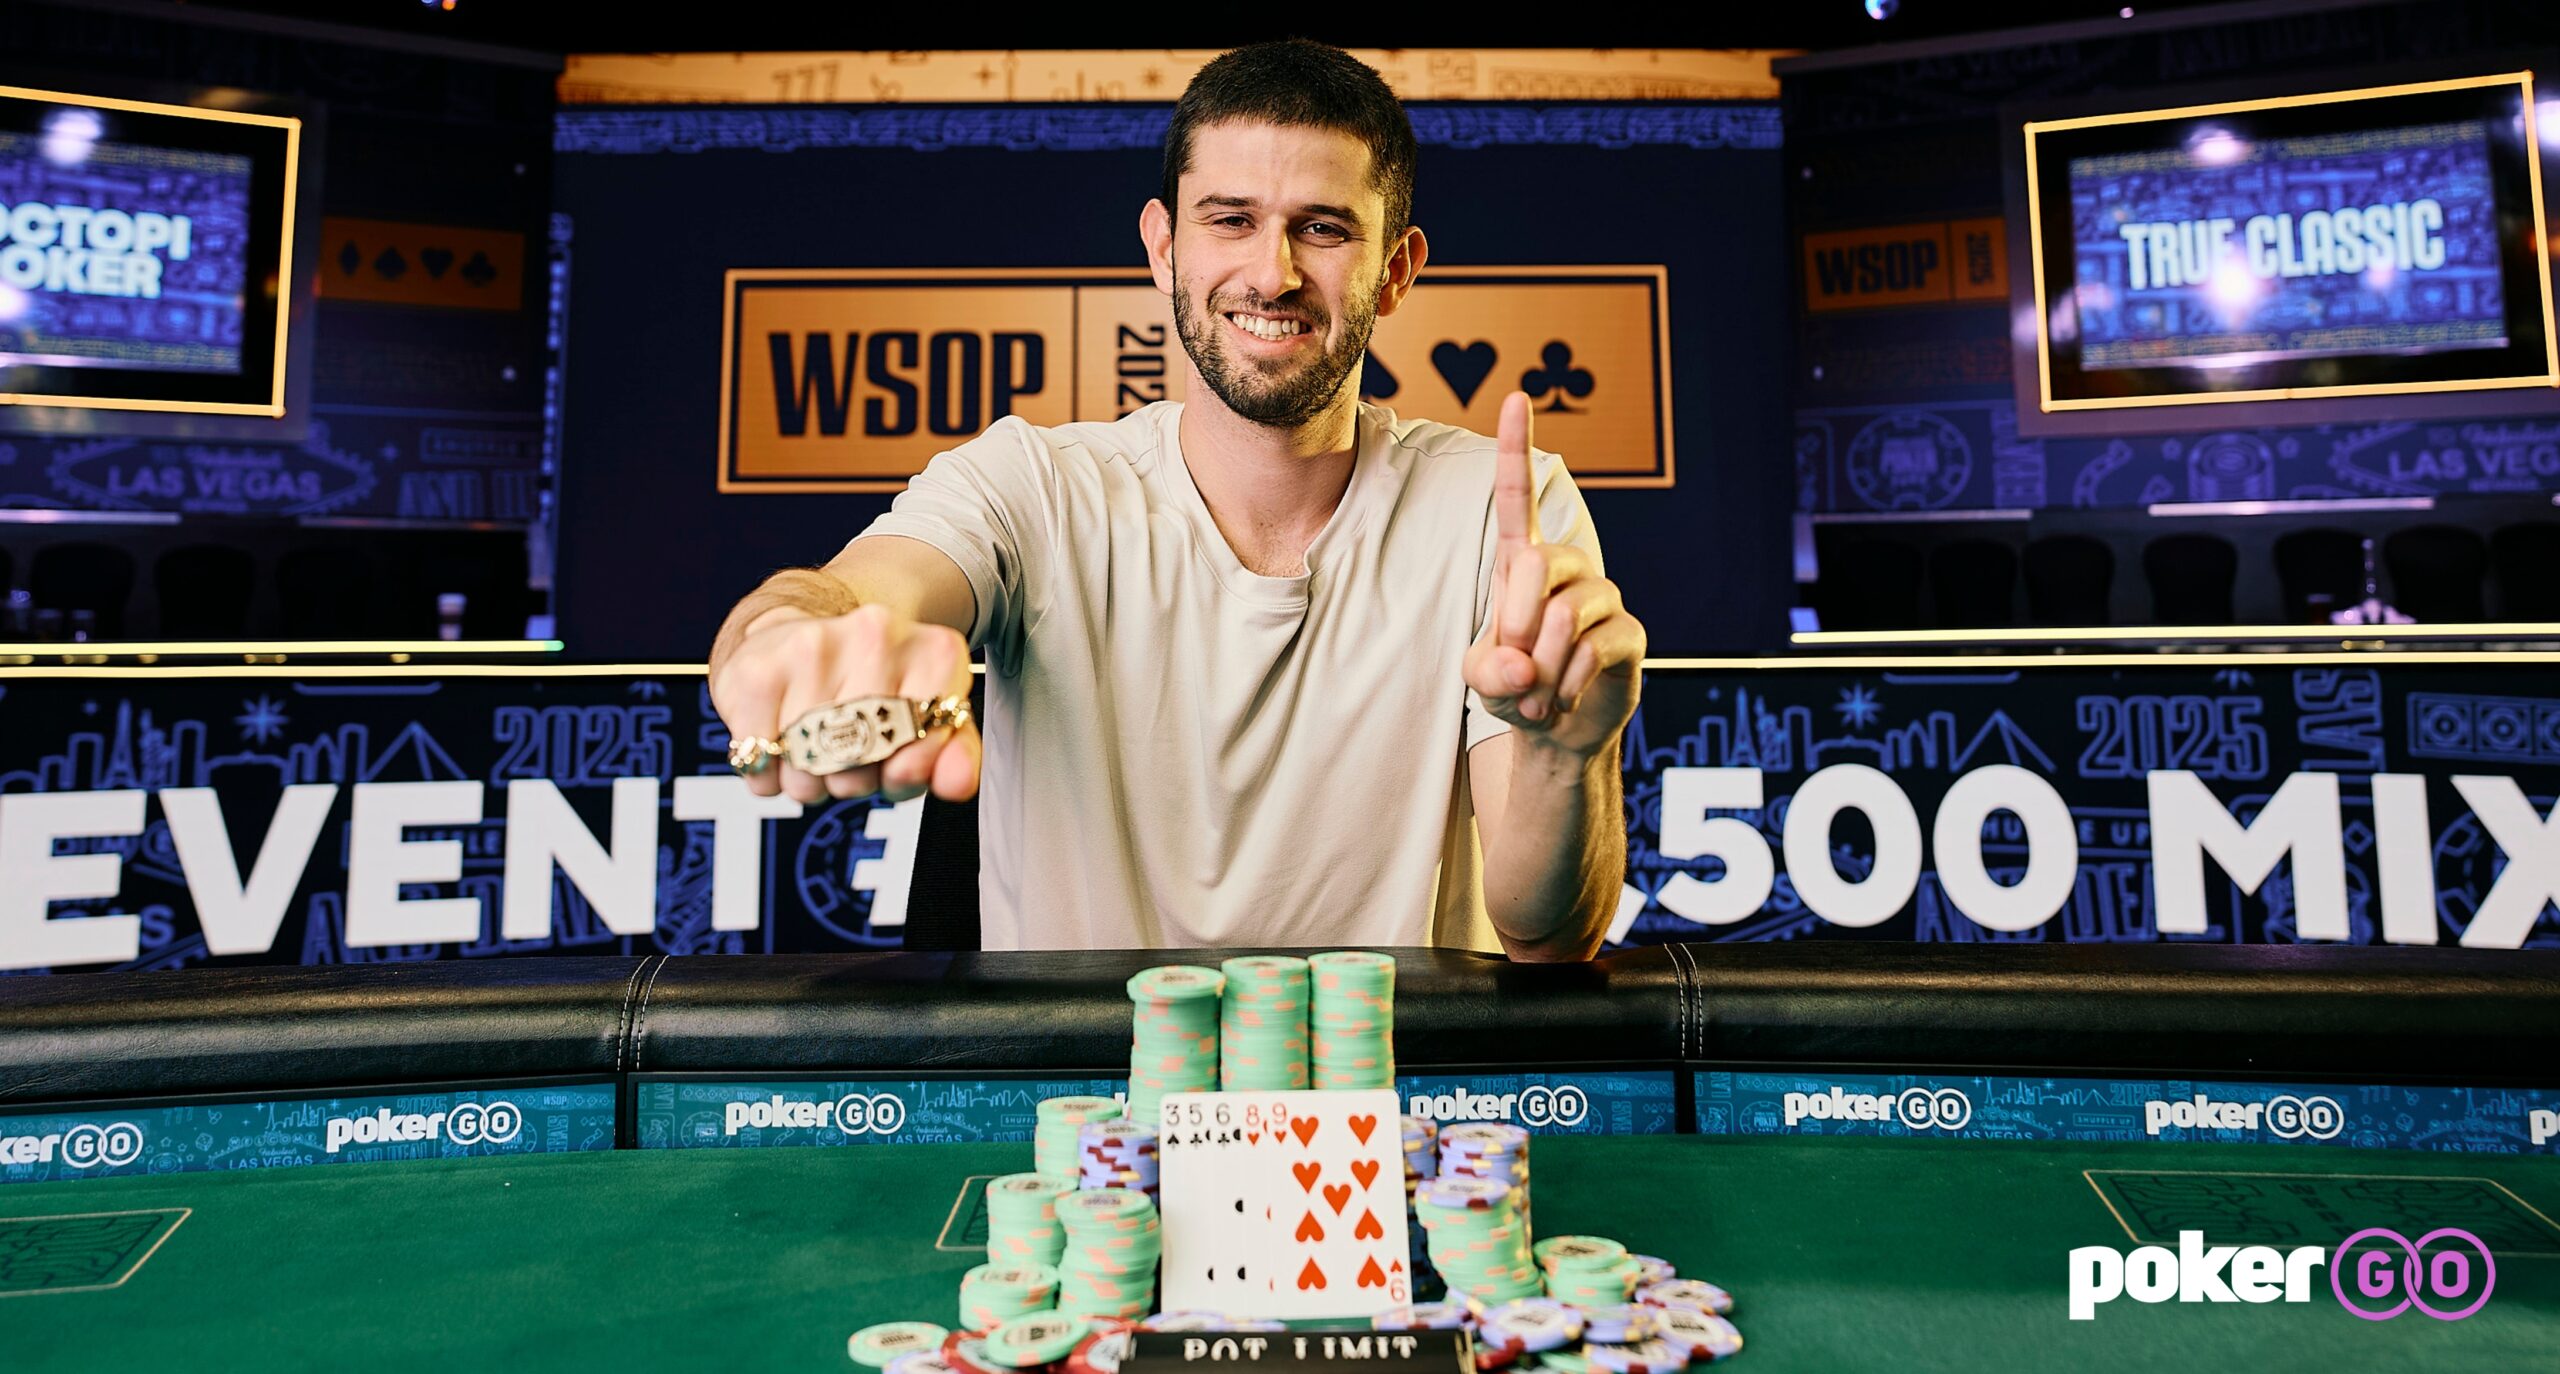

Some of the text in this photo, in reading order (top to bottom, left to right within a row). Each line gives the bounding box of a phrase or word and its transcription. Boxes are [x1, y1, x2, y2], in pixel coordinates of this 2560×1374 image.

[1815, 240, 1938, 295] WSOP
[2119, 198, 2446, 290] TRUE CLASSIC
[768, 331, 1045, 437] WSOP
[1117, 324, 1167, 419] 202
[106, 468, 322, 499] LAS VEGAS
[490, 705, 673, 788] 2025
[2076, 696, 2269, 781] 2025
[0, 776, 803, 970] EVENT
[543, 1095, 568, 1106] WSOP
[1005, 1116, 1037, 1125] SHUFFL
[1165, 1102, 1288, 1127] 3 5 6 8 9
[229, 1154, 314, 1170] LAS VEGAS
[887, 1134, 963, 1144] LAS VEGAS
